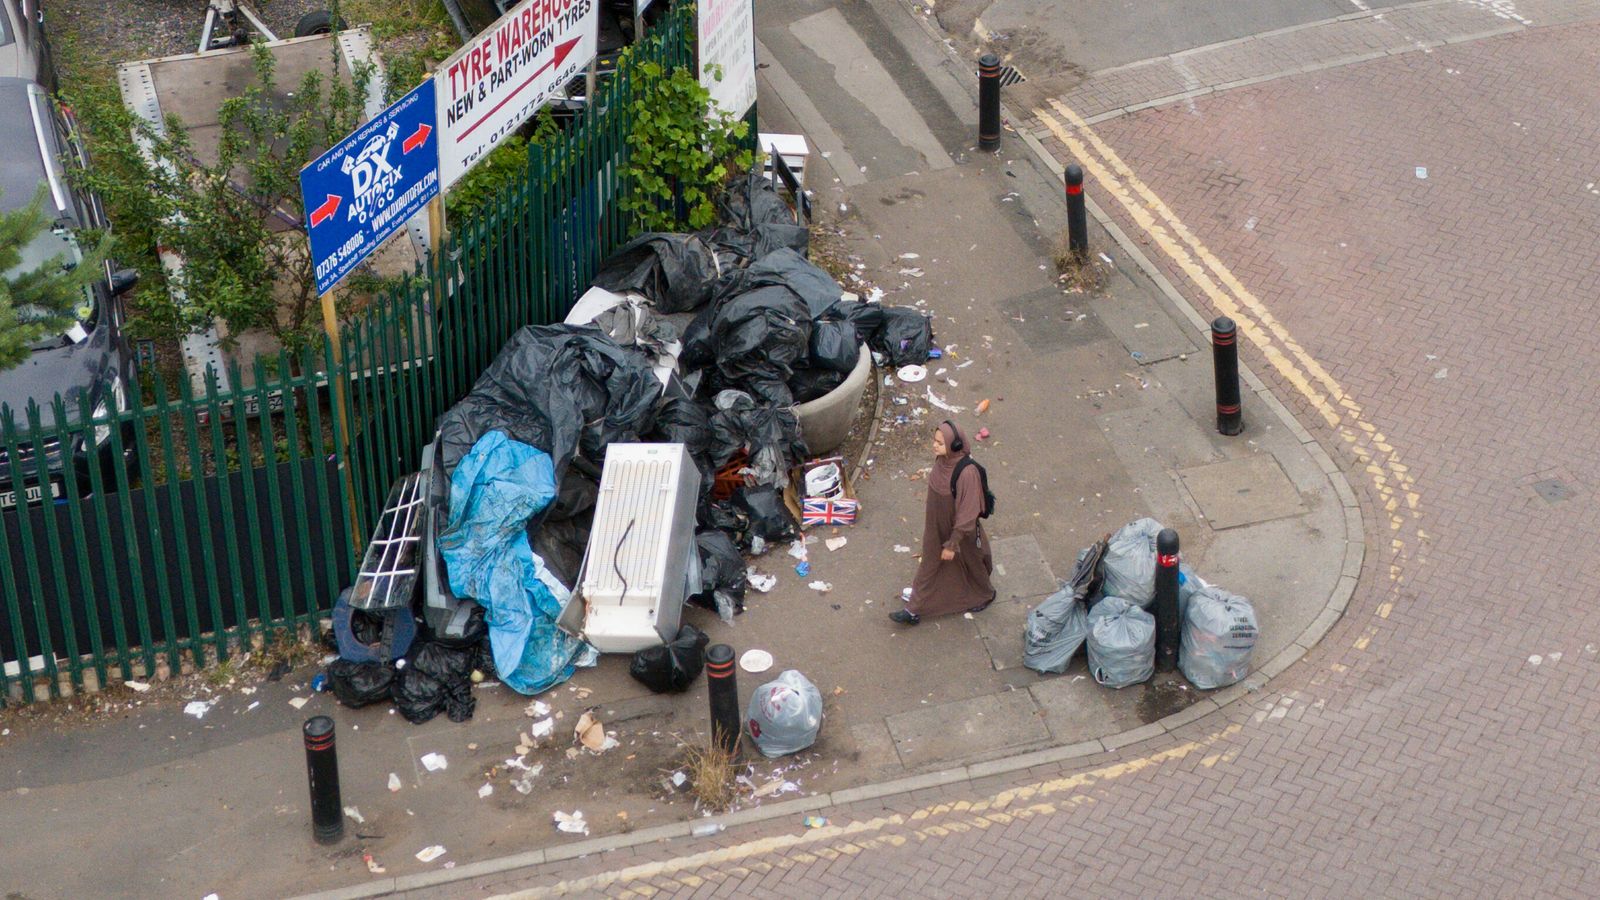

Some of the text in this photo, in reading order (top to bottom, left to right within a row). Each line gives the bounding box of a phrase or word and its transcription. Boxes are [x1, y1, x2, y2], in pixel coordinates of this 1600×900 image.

[447, 0, 591, 128] NEW & PART-WORN TYRES
[448, 37, 492, 101] TYRE
[547, 62, 577, 93] 6646
[317, 92, 419, 172] CAR AND VAN REPAIRS & SERVICING
[347, 164, 403, 222] AUTOFIX
[351, 141, 394, 199] DX
[316, 252, 338, 280] 07376
[337, 230, 364, 261] 548006
[371, 167, 438, 232] WWW.DXAUTOFIX.COM
